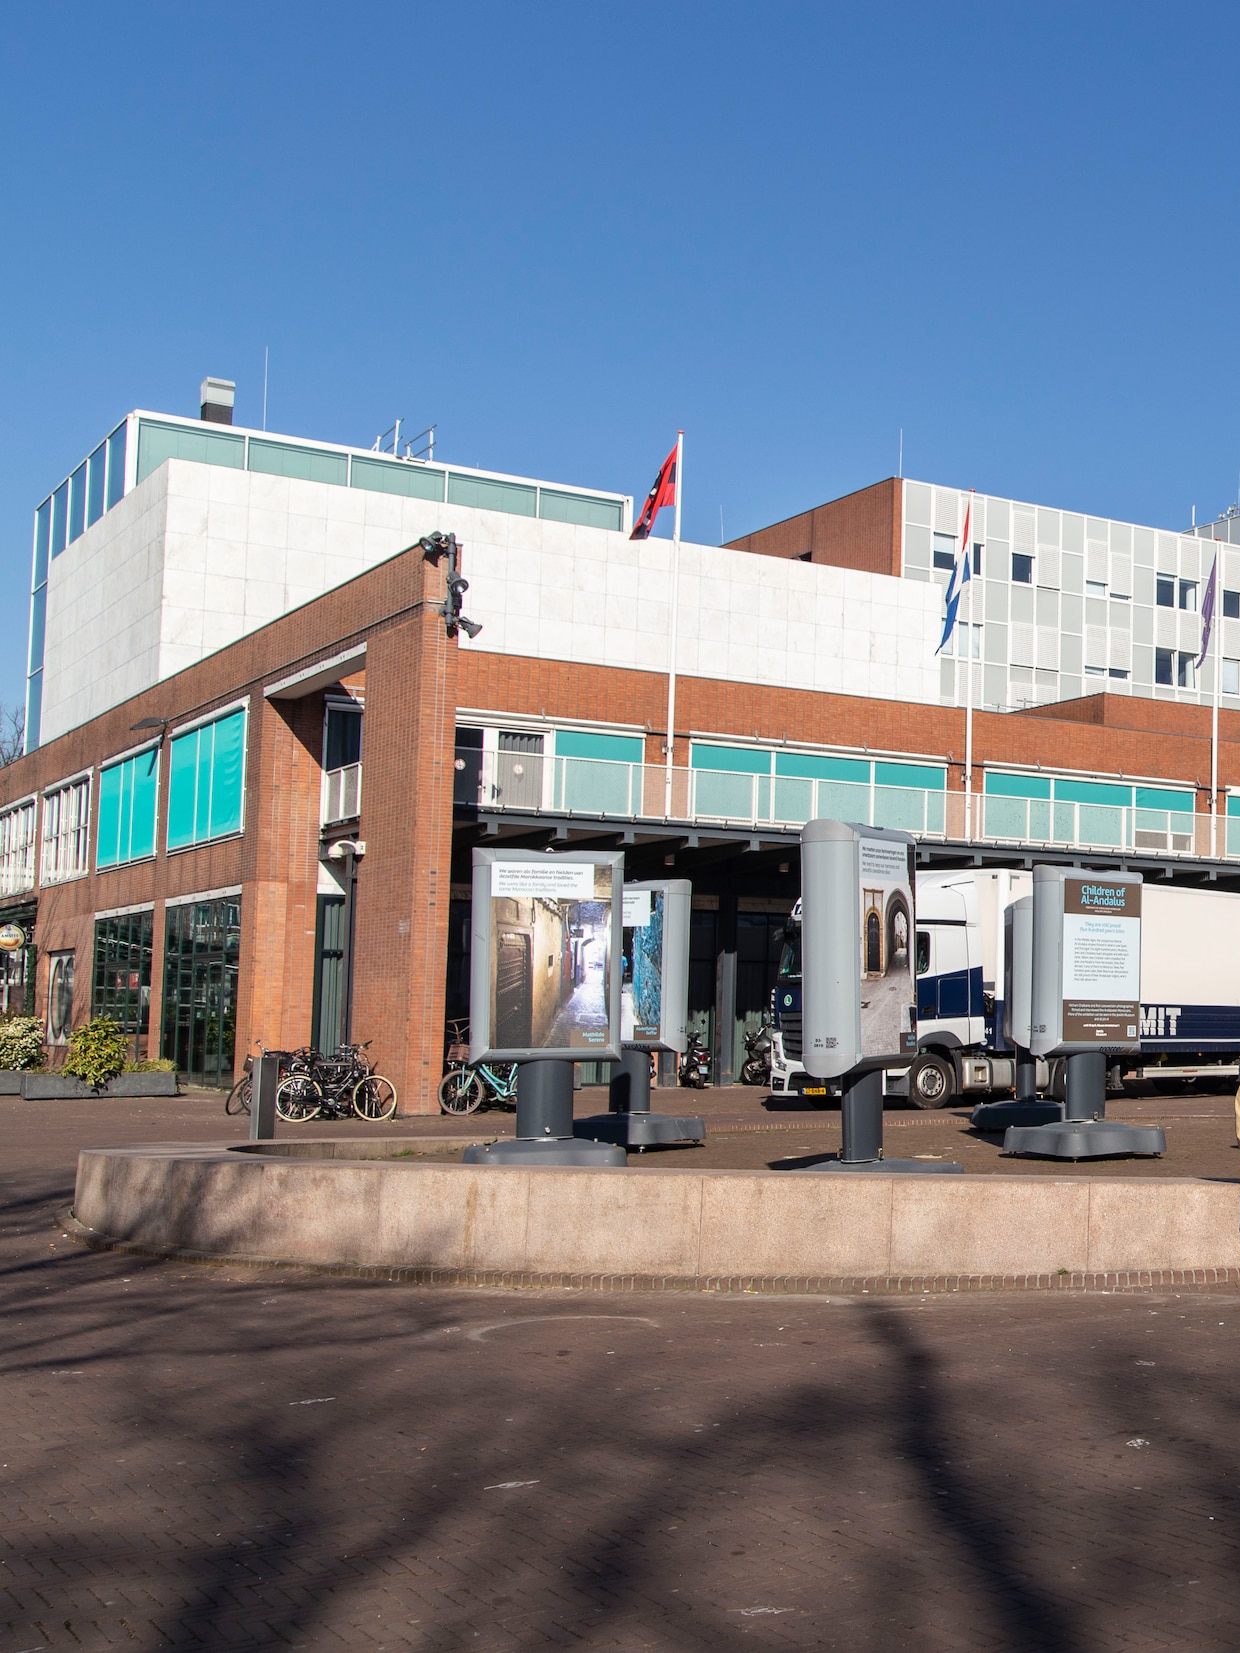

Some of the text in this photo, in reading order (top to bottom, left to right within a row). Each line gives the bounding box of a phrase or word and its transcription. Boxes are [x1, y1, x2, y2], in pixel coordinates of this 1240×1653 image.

[1081, 885, 1126, 897] Children of
[1081, 895, 1125, 906] Al-Andalus
